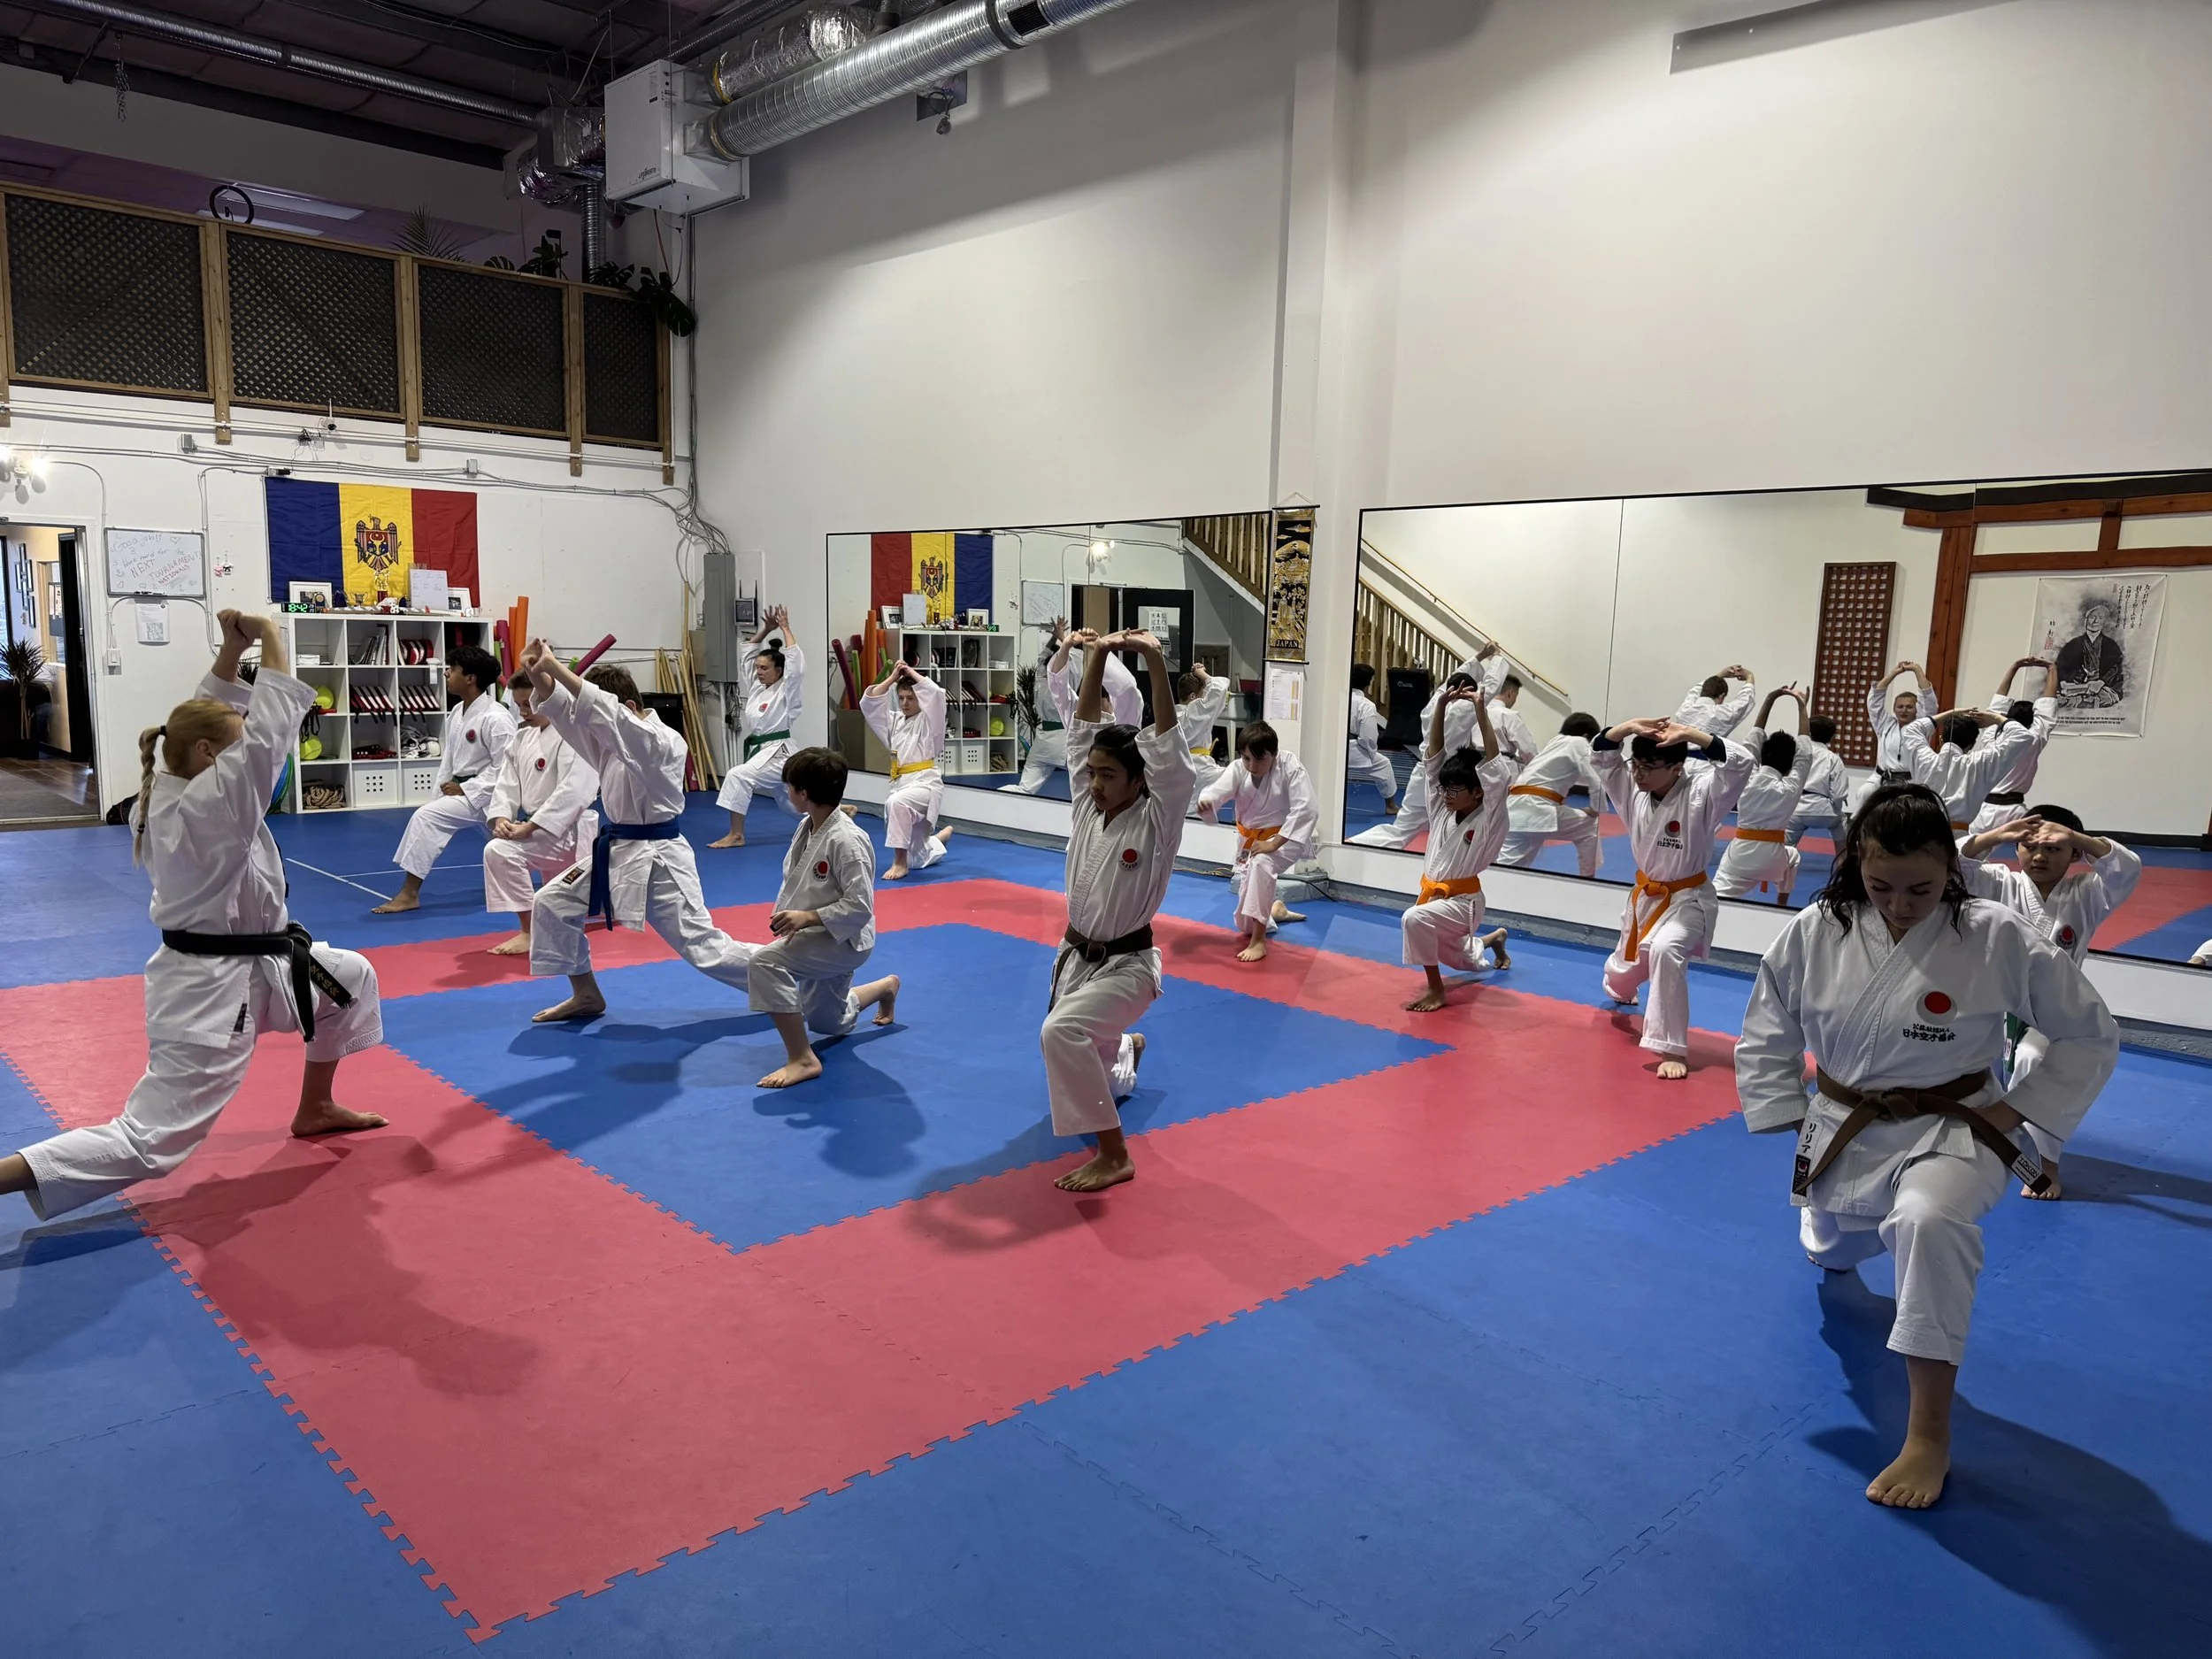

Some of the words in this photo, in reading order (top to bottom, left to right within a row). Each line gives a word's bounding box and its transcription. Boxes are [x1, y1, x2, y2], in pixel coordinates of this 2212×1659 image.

[130, 559, 156, 578] NEXT
[1801, 1122, 1816, 1154] リリア
